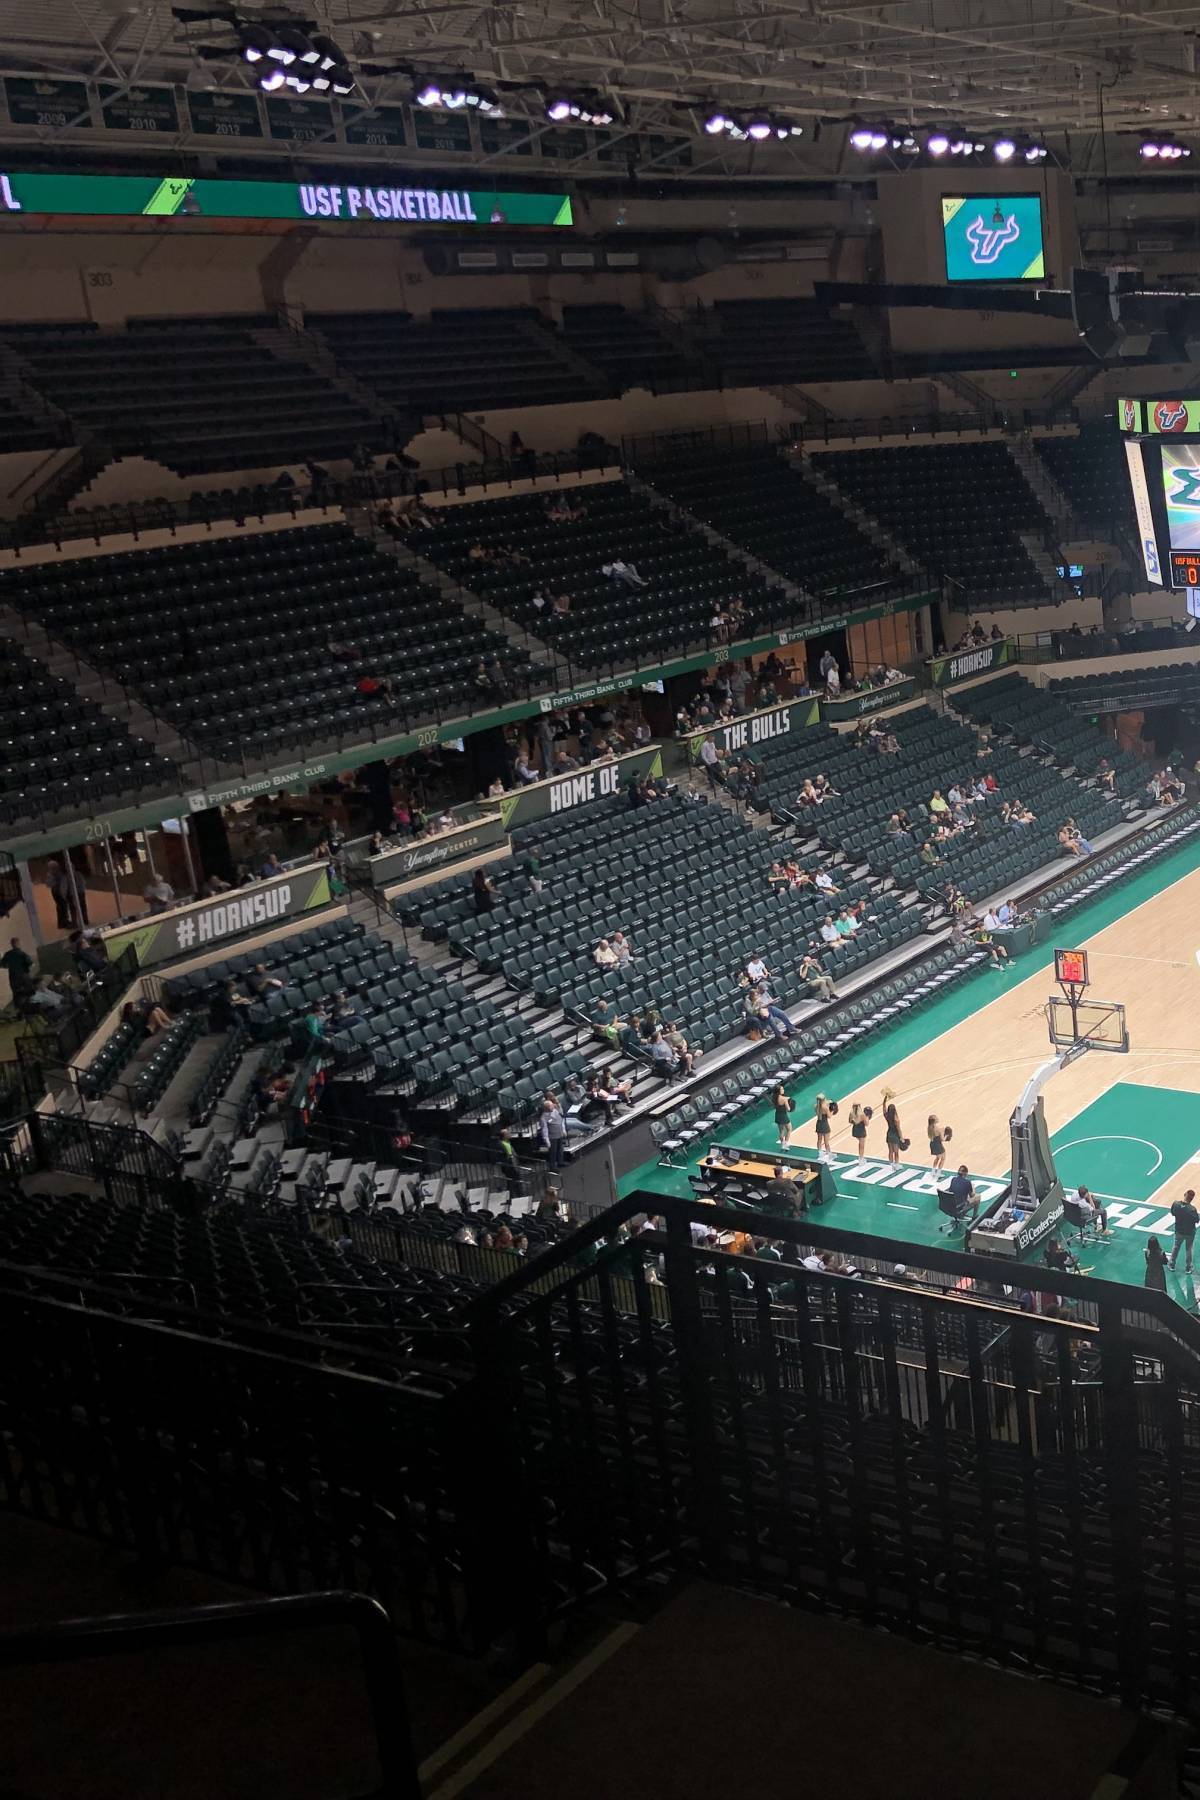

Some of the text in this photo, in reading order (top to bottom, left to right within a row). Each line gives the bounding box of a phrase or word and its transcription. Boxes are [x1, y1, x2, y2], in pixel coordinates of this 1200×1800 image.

[37, 112, 66, 125] 2009
[128, 118, 156, 131] 2010
[299, 185, 478, 221] USF BASKETBALL
[88, 272, 112, 287] 303
[1187, 567, 1198, 584] 0
[714, 649, 729, 664] 203
[949, 647, 993, 679] #HORNSUP
[552, 678, 633, 707] FIFTH THIRD BANK CLUB
[418, 730, 439, 748] 202
[723, 708, 790, 751] THE BULLS
[208, 764, 326, 804] FIFTH THIRD BANK CLUB
[550, 764, 620, 814] HOME OF
[85, 820, 112, 842] 201
[403, 836, 479, 872] Yuengling CENTER
[176, 884, 291, 949] #HORNSUP
